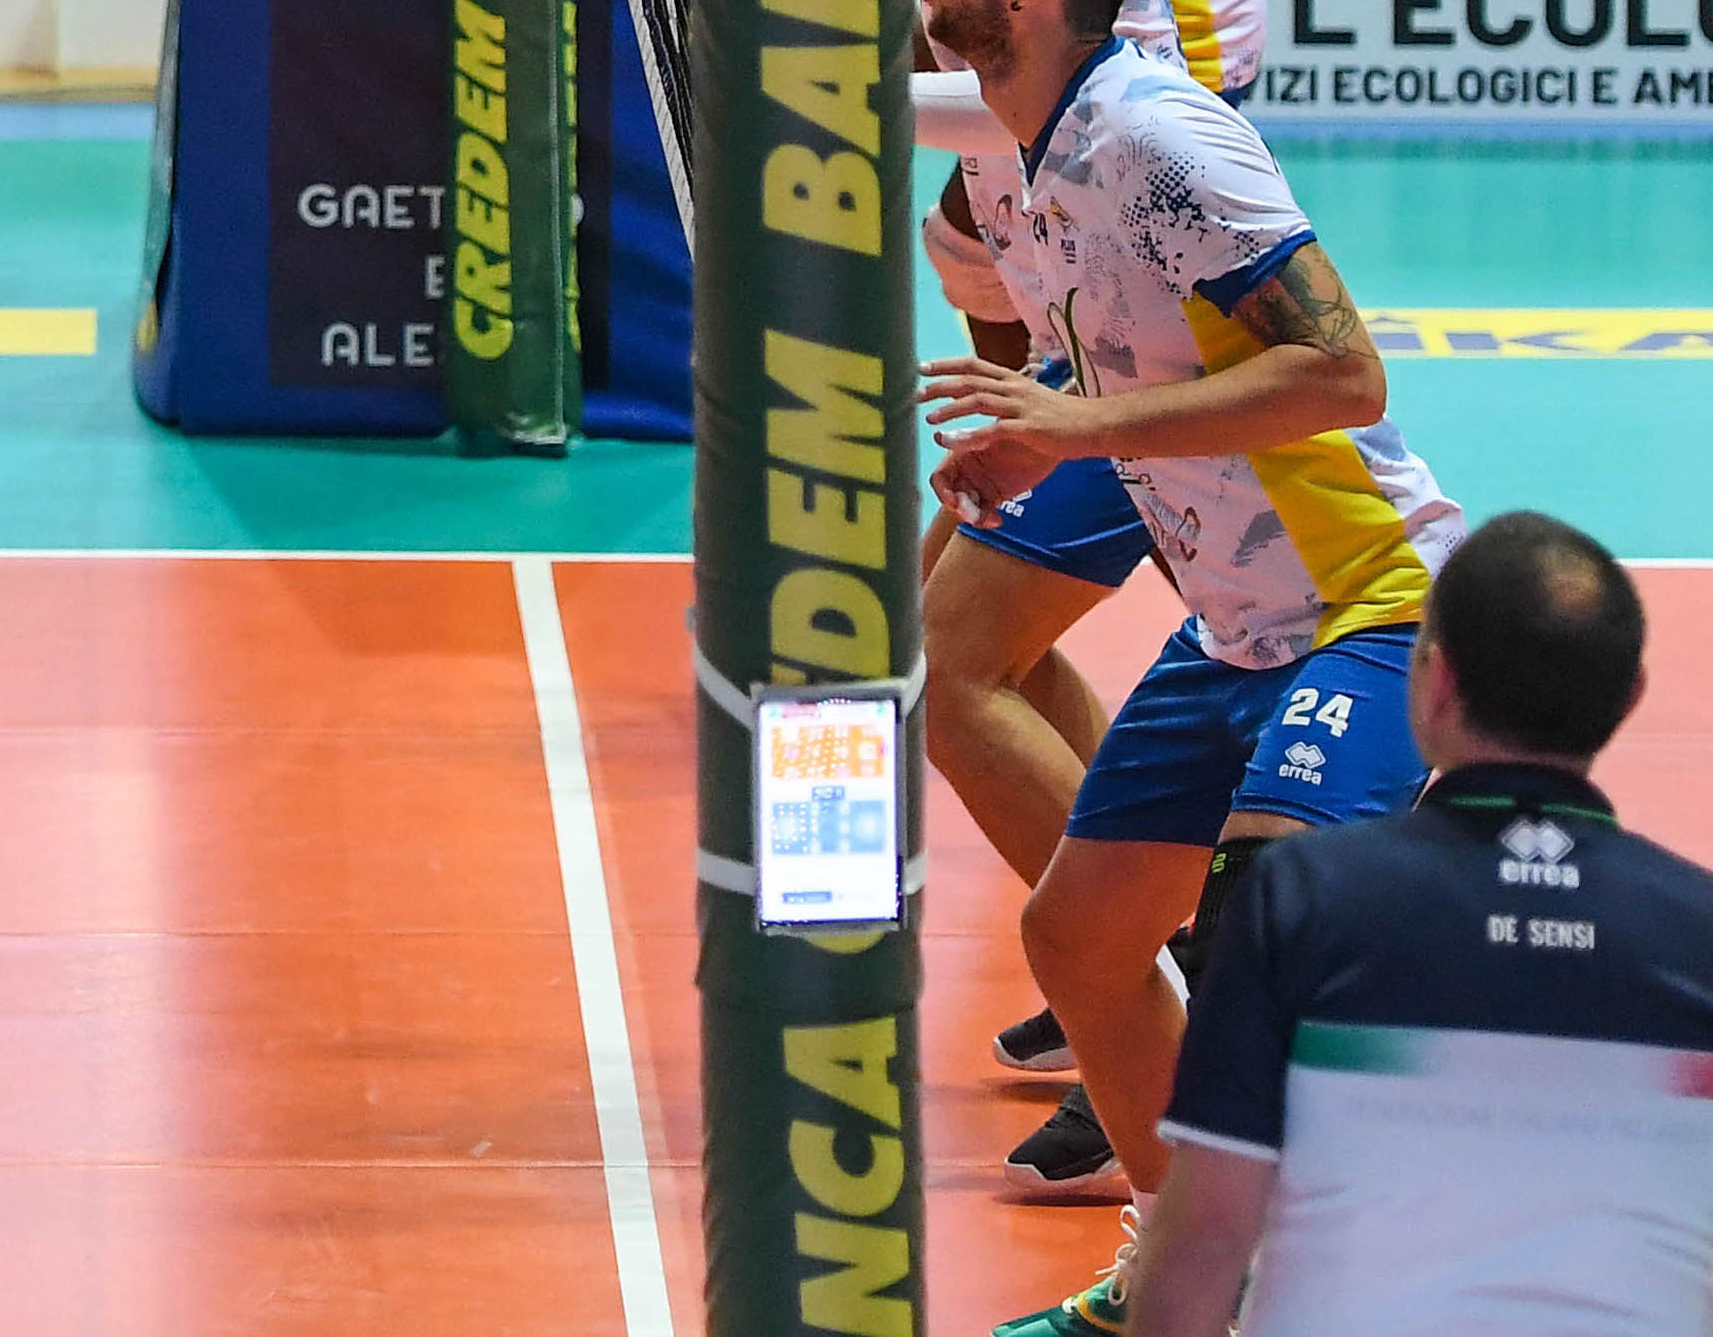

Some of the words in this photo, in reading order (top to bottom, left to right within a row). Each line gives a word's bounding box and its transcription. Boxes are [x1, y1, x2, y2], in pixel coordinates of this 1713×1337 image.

[1335, 67, 1576, 104] ECOLOGICI
[1593, 67, 1617, 104] E
[296, 182, 450, 230] GAET
[320, 322, 436, 367] ALE
[998, 500, 1025, 517] rea
[1282, 688, 1352, 737] 24
[1279, 762, 1322, 786] errea
[1499, 861, 1581, 891] errea
[1487, 914, 1518, 944] DE
[1528, 916, 1596, 951] SENSI
